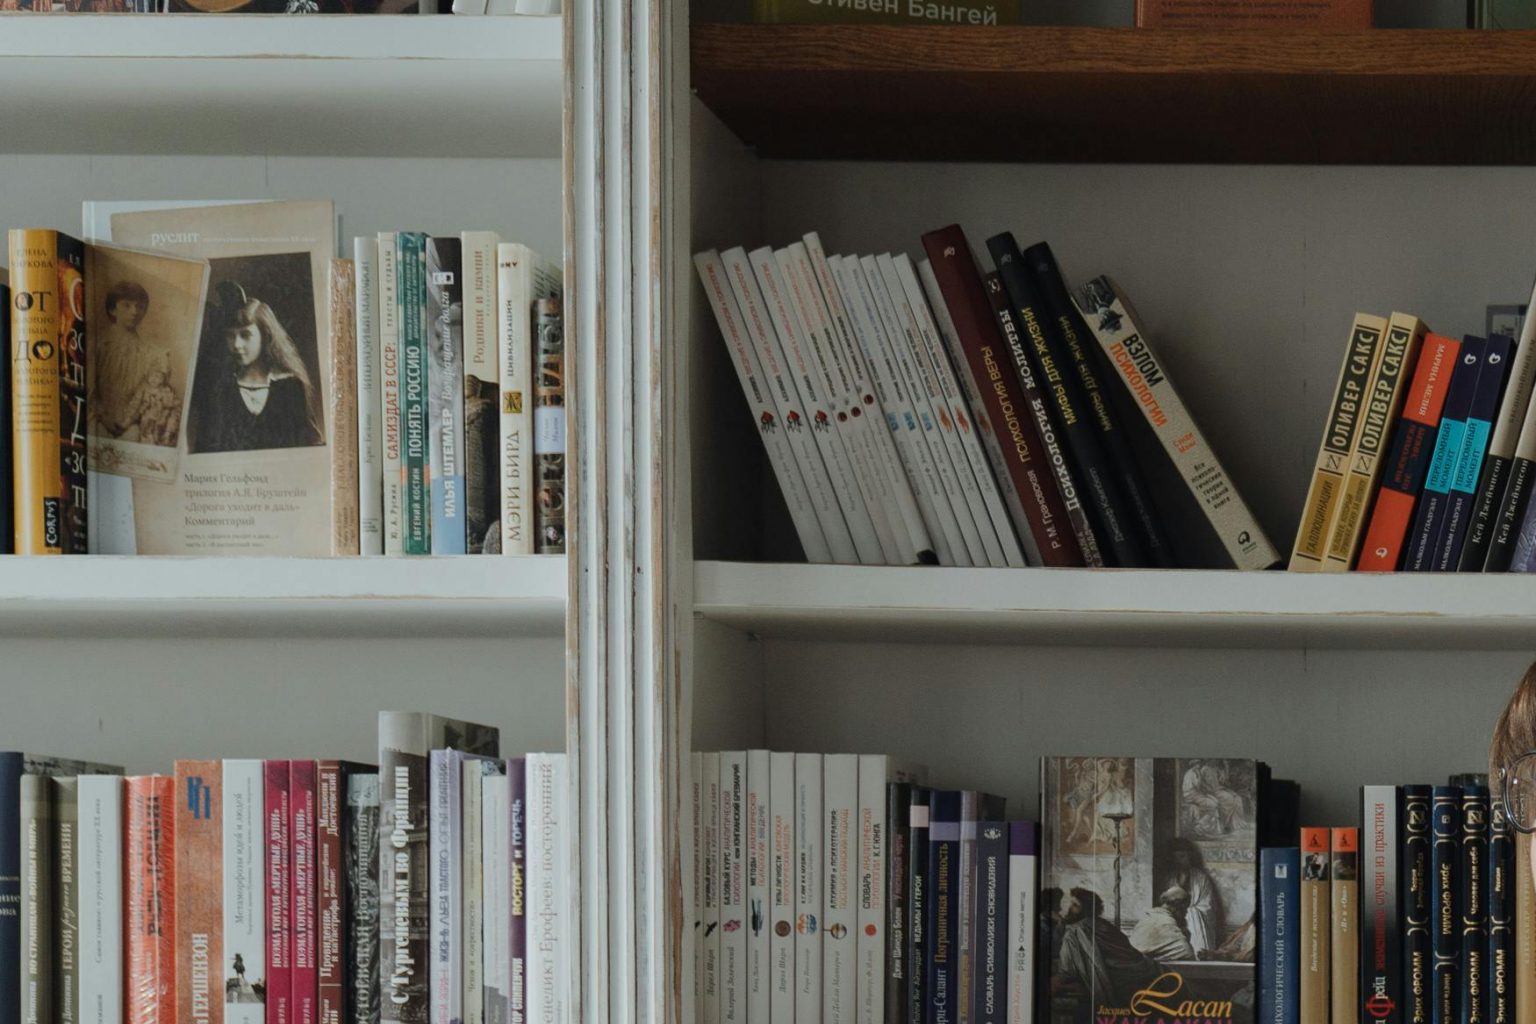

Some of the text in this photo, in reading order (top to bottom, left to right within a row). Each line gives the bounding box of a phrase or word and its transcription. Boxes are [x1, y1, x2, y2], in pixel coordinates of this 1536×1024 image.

[908, 0, 997, 26] Бангей
[384, 342, 396, 376] СССР:
[406, 347, 422, 456] ПОНЯТЬ РОССИЮ
[1022, 307, 1078, 424] МИФЫ ДЛЯ ЖИЗНИ
[1109, 342, 1168, 427] ПСИХОЛОГИИ
[1122, 333, 1164, 387] ВЗЛОМ
[386, 388, 399, 460] САМИЗДАТ
[440, 291, 455, 517] ИЛЬЯ ШТЕМЛЕР Возвращение долга
[981, 345, 1031, 462] ПСИХОЛОГИЯ ВЕРЫ
[1305, 332, 1375, 553] ГАЛЛЮЦИНАЦИИ ОЛИВЕР САКС
[506, 431, 521, 541] МЭРИ БИРД
[539, 763, 554, 871] посторонний
[391, 766, 414, 1004] С Тургеневым во Франции
[540, 877, 556, 952] Ерофеев:
[1276, 892, 1286, 936] СЛОВАРЬ
[192, 933, 209, 1017] ГЕРШЕНЗОН
[985, 856, 996, 1014] СЛОВАРЬ СИМВОЛИКИ СНОВИДЕНИЙ
[1097, 971, 1233, 1018] Jacques Lacan
[1365, 976, 1395, 1018] Фрейд
